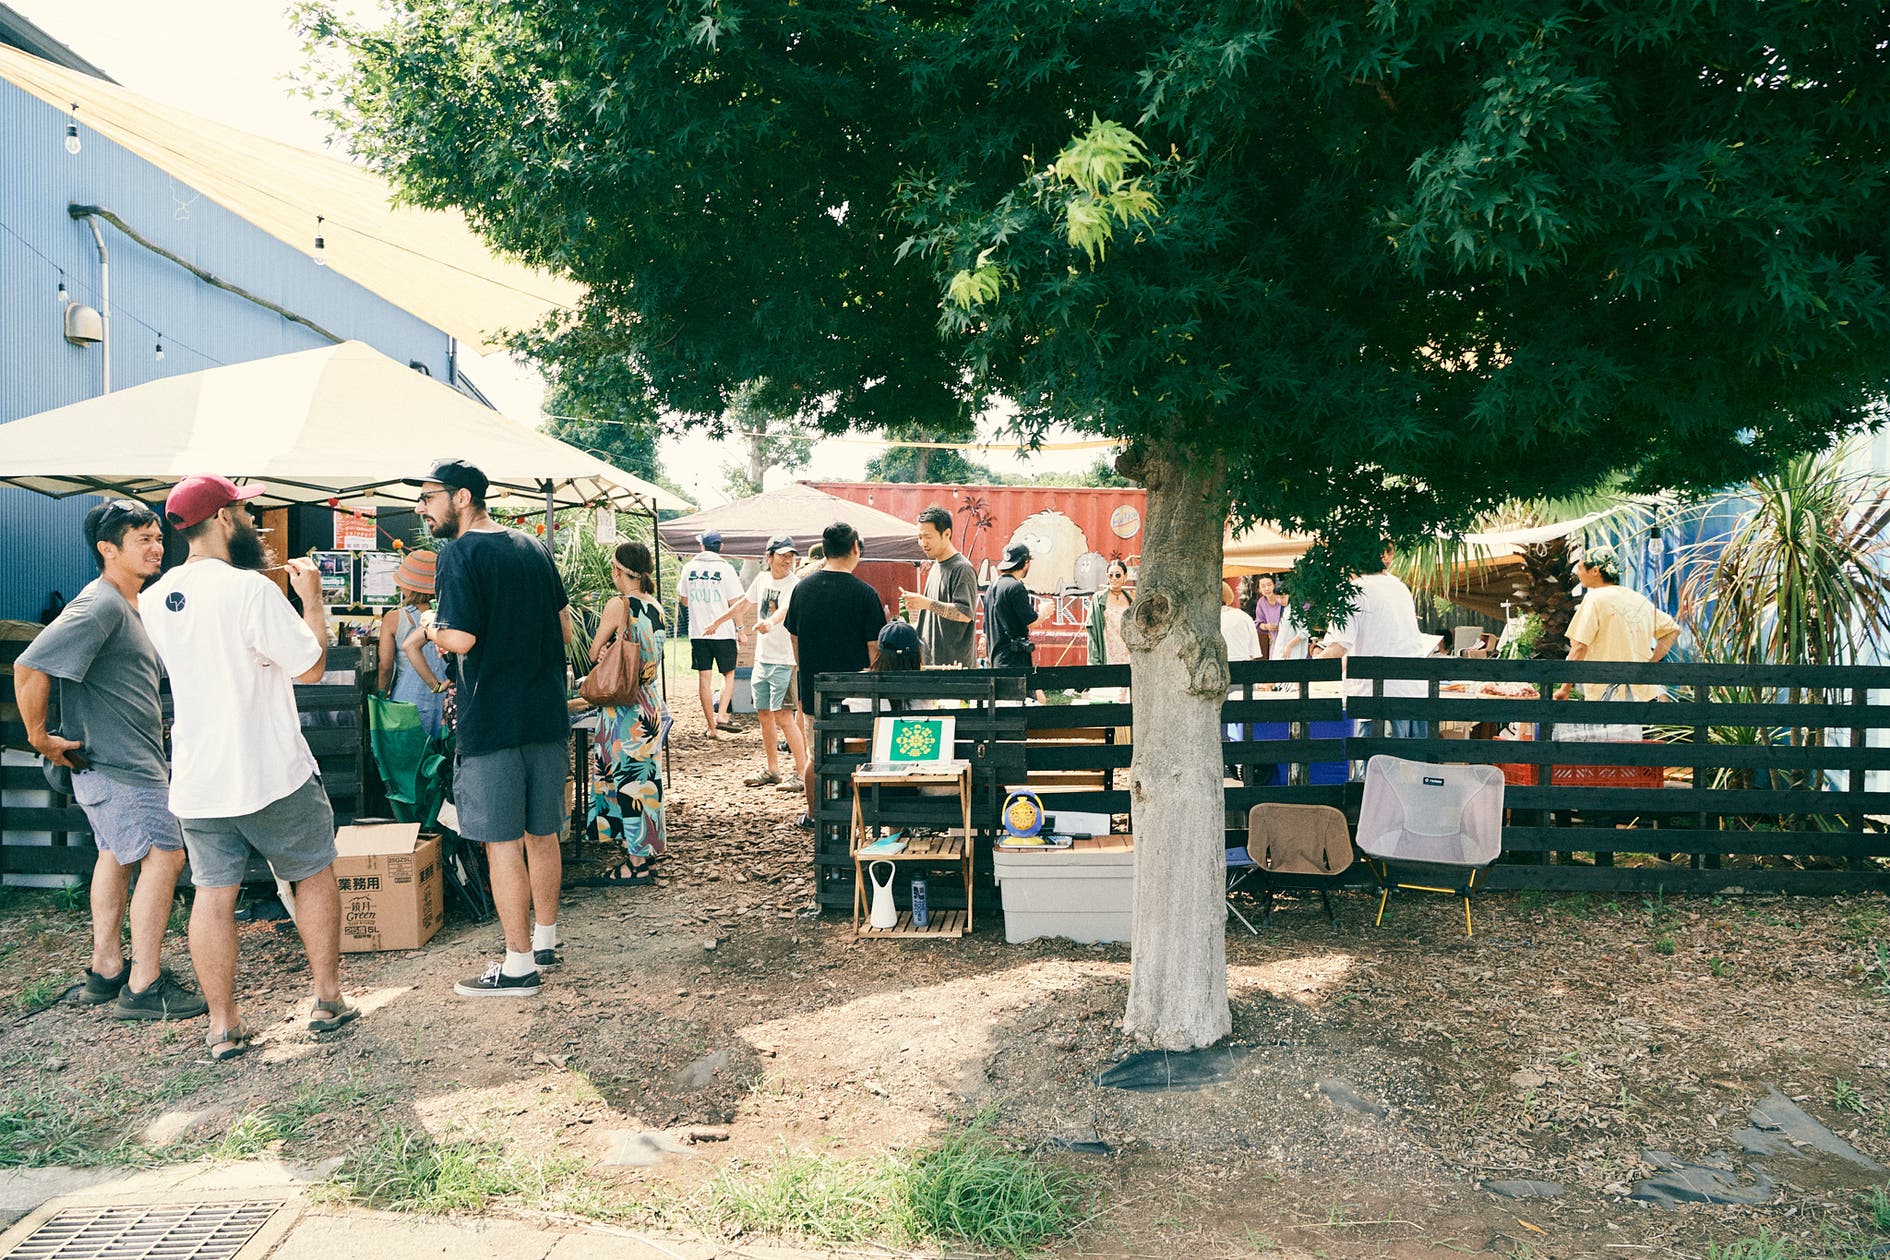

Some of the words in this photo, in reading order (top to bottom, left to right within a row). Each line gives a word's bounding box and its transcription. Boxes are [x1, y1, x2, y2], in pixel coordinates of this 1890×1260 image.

[338, 877, 379, 891] 業務用
[346, 911, 376, 921] Green
